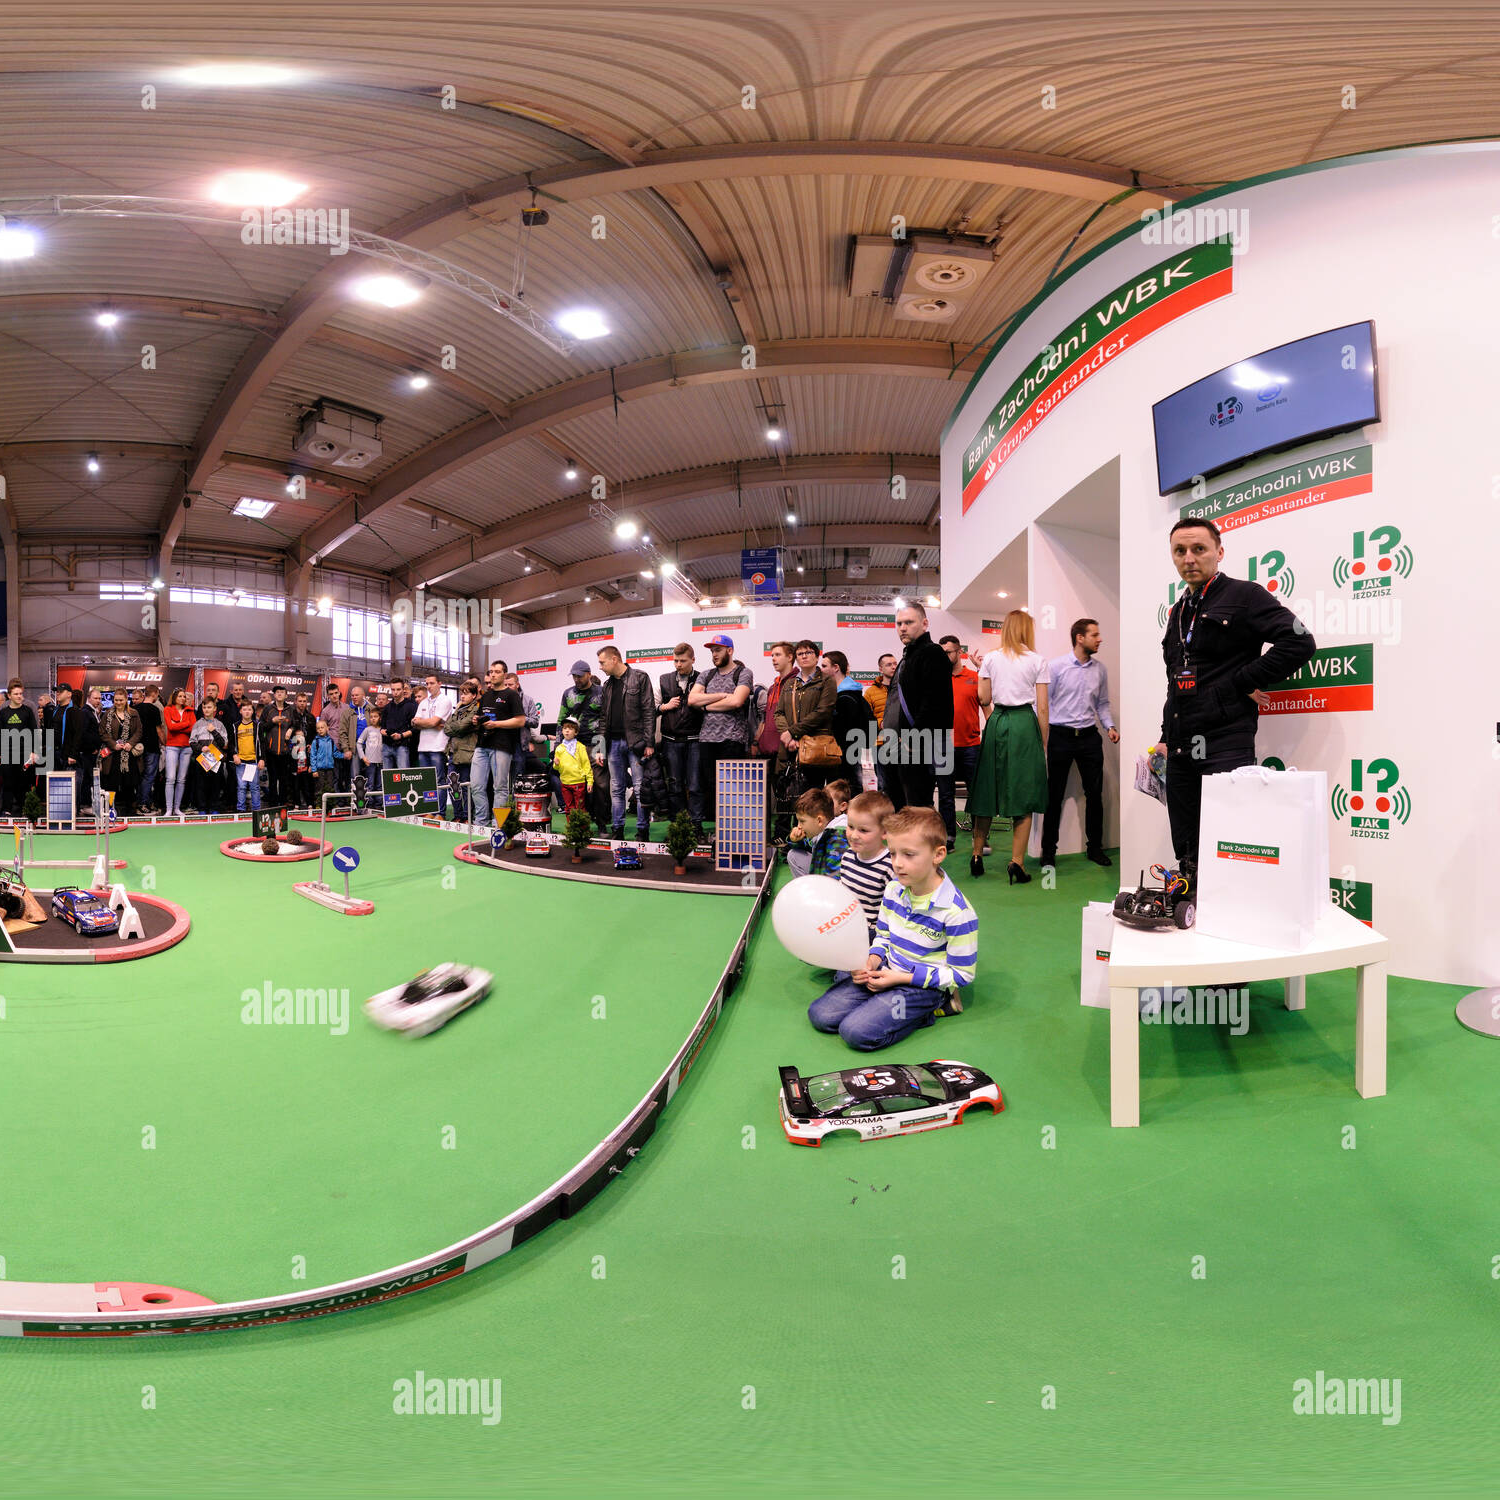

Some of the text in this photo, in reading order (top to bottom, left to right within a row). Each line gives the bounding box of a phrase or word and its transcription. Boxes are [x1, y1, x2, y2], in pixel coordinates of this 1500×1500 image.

[968, 258, 1194, 472] Bank Zachodni WBK
[998, 333, 1129, 464] Grupa Santander
[1188, 456, 1357, 519] Bank Zachodni WBK
[1224, 490, 1328, 530] Grupa Santander
[1360, 578, 1382, 590] JAK
[1308, 656, 1357, 678] WBK
[247, 674, 303, 685] ODPAL TURBO
[1177, 681, 1196, 690] VIP
[1262, 694, 1327, 712] Santander
[401, 773, 423, 781] Poznań
[1358, 817, 1382, 830] JAK
[1220, 843, 1276, 857] Bank Zachodni WBK
[1329, 888, 1357, 910] BK
[828, 1116, 884, 1127] YOKOHAMA
[58, 1321, 173, 1331] Bank
[190, 1291, 368, 1326] Zachodni
[379, 1264, 448, 1292] WBK
